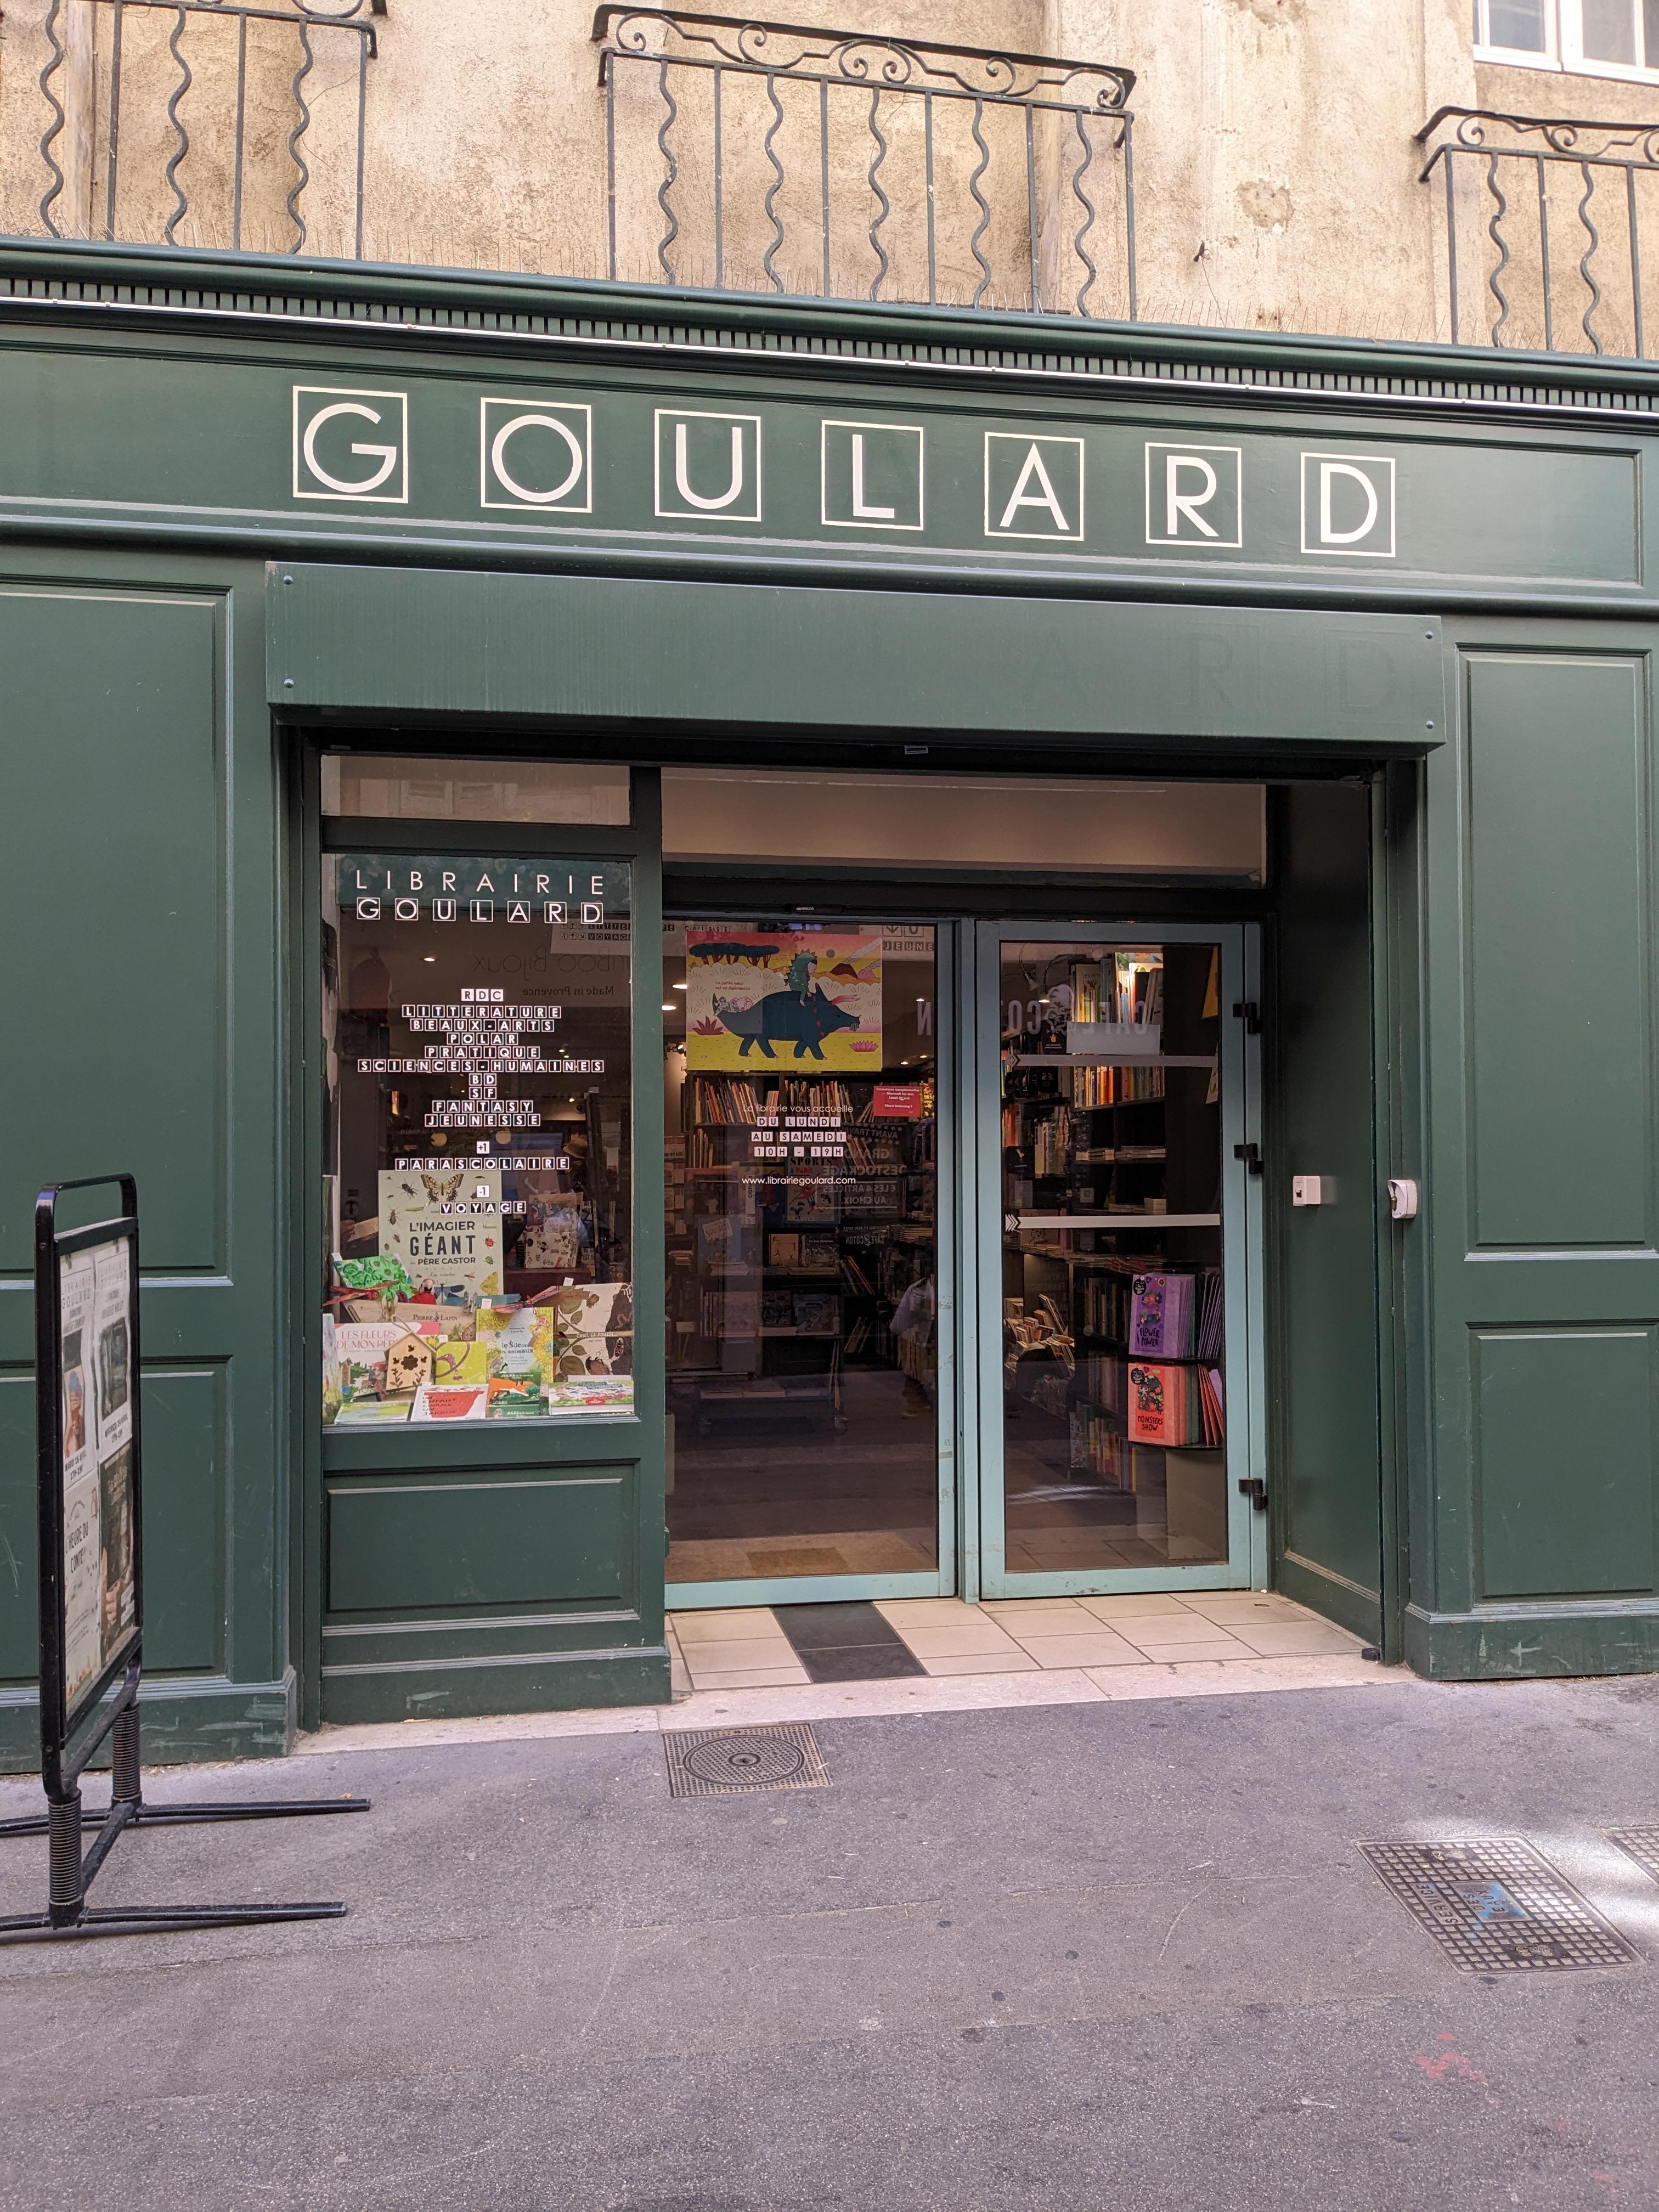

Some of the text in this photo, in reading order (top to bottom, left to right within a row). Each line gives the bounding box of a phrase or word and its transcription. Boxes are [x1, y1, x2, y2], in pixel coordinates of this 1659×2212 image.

[300, 399, 1383, 548] GOULARD
[357, 870, 603, 895] LIBRAIRIE
[357, 897, 603, 924] GOULARD
[461, 989, 503, 1002] RDC
[402, 1005, 561, 1019] LITTERATURE
[410, 1019, 554, 1032] BEAUX-ARTS
[447, 1032, 518, 1046] POLAR
[425, 1046, 540, 1059] PRATIQUE
[358, 1059, 604, 1073] SCIENCES-HUMAINES
[469, 1073, 497, 1086] BD
[469, 1086, 497, 1099] SF
[432, 1100, 533, 1113] FANTASY
[743, 1104, 754, 1113] La
[756, 1103, 788, 1113] librairie
[812, 1104, 854, 1113] accueille
[425, 1114, 540, 1127] JEUNESSE
[757, 1116, 841, 1127] DU LUNDI
[751, 1131, 847, 1143] AU SAMEDI
[476, 1141, 489, 1154] +1
[754, 1147, 788, 1158] 10H
[810, 1147, 844, 1158] 19H
[395, 1157, 569, 1171] PARASCOLAIRE
[790, 1156, 833, 1166] SPORTS
[742, 1175, 856, 1186] www.librairiegoulard.com
[477, 1185, 489, 1198] -1
[440, 1201, 526, 1215] VOYAGE
[409, 1221, 475, 1232] L'IMAGIER
[410, 1233, 476, 1256] GÉANT
[341, 1330, 396, 1340] LES FLEURS
[1139, 1327, 1160, 1339] FLOWER
[337, 1340, 349, 1349] DE
[351, 1340, 375, 1348] MON
[1141, 1337, 1159, 1347] POWER
[1137, 1415, 1163, 1425] MONSTERS
[1415, 1882, 1460, 1924] SERVICE
[1463, 1893, 1486, 1912] DES
[1476, 1888, 1506, 1914] EAUX
